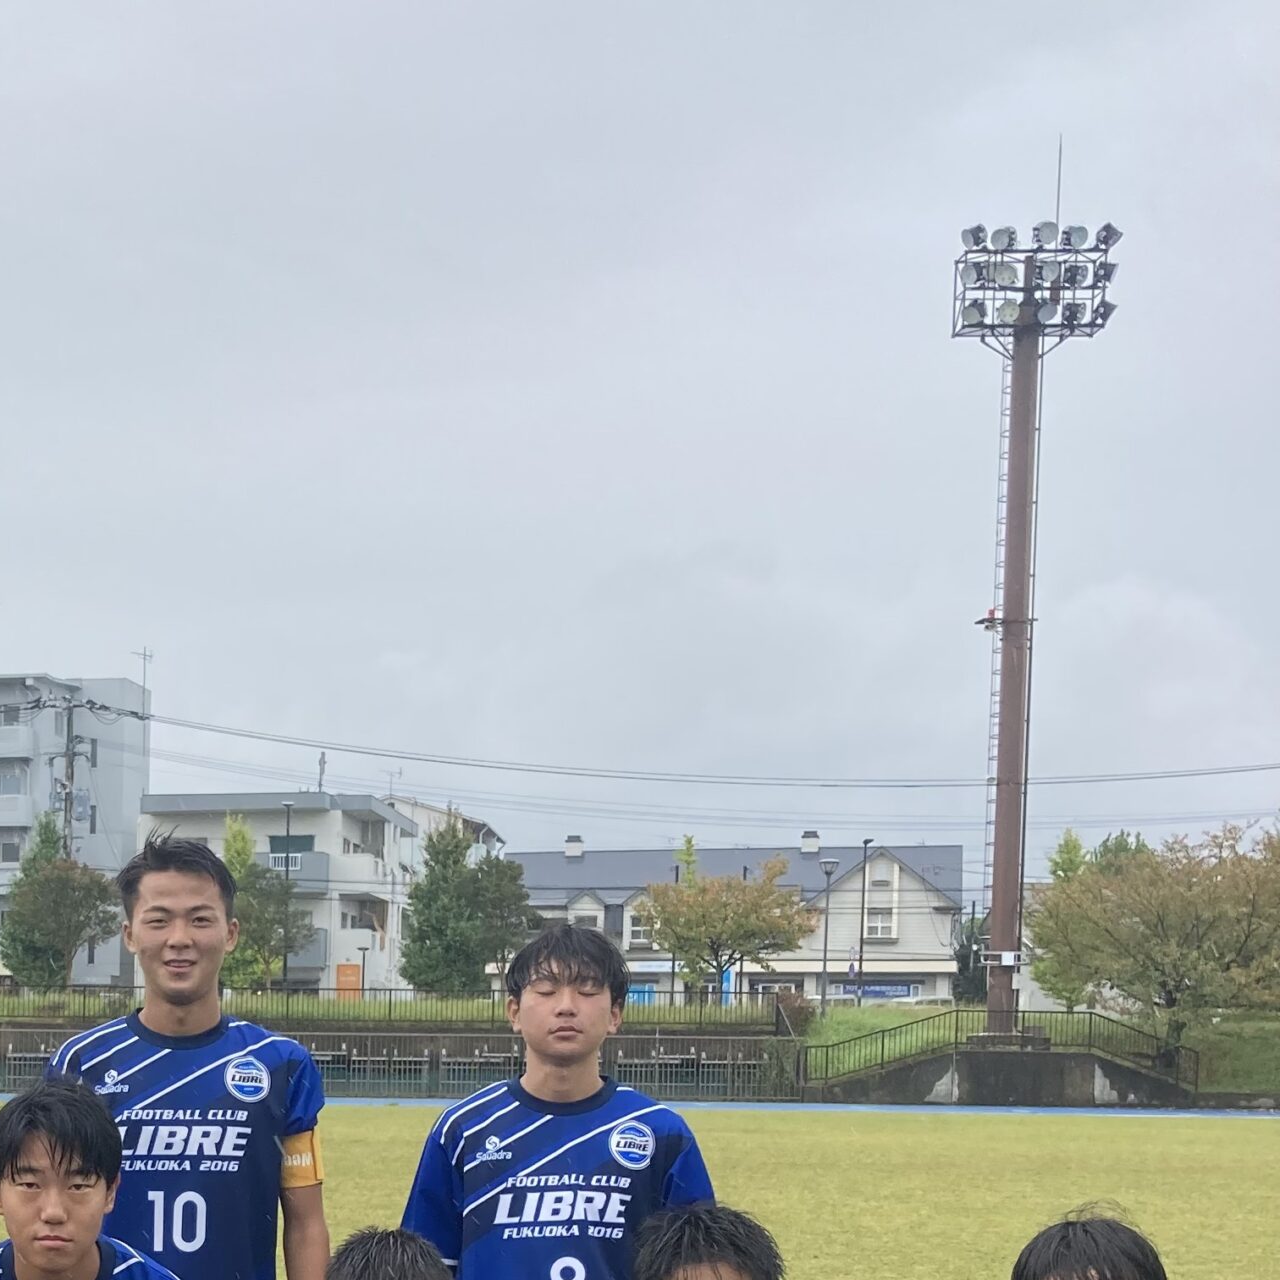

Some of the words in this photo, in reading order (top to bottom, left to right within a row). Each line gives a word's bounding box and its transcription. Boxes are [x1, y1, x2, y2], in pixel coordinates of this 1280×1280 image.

[231, 1074, 265, 1086] LIBRE
[122, 1109, 202, 1121] FOOTBALL
[207, 1109, 249, 1122] CLUB
[119, 1125, 252, 1157] LIBRE
[615, 1140, 650, 1152] LIBRE
[120, 1160, 191, 1171] FUKUOKA
[199, 1161, 240, 1172] 2016
[506, 1173, 586, 1188] FOOTBALL
[590, 1175, 632, 1189] CLUB
[493, 1190, 632, 1225] LIBRE
[148, 1190, 207, 1253] 10
[503, 1224, 580, 1240] FUKUOKA
[588, 1226, 625, 1239] 2016
